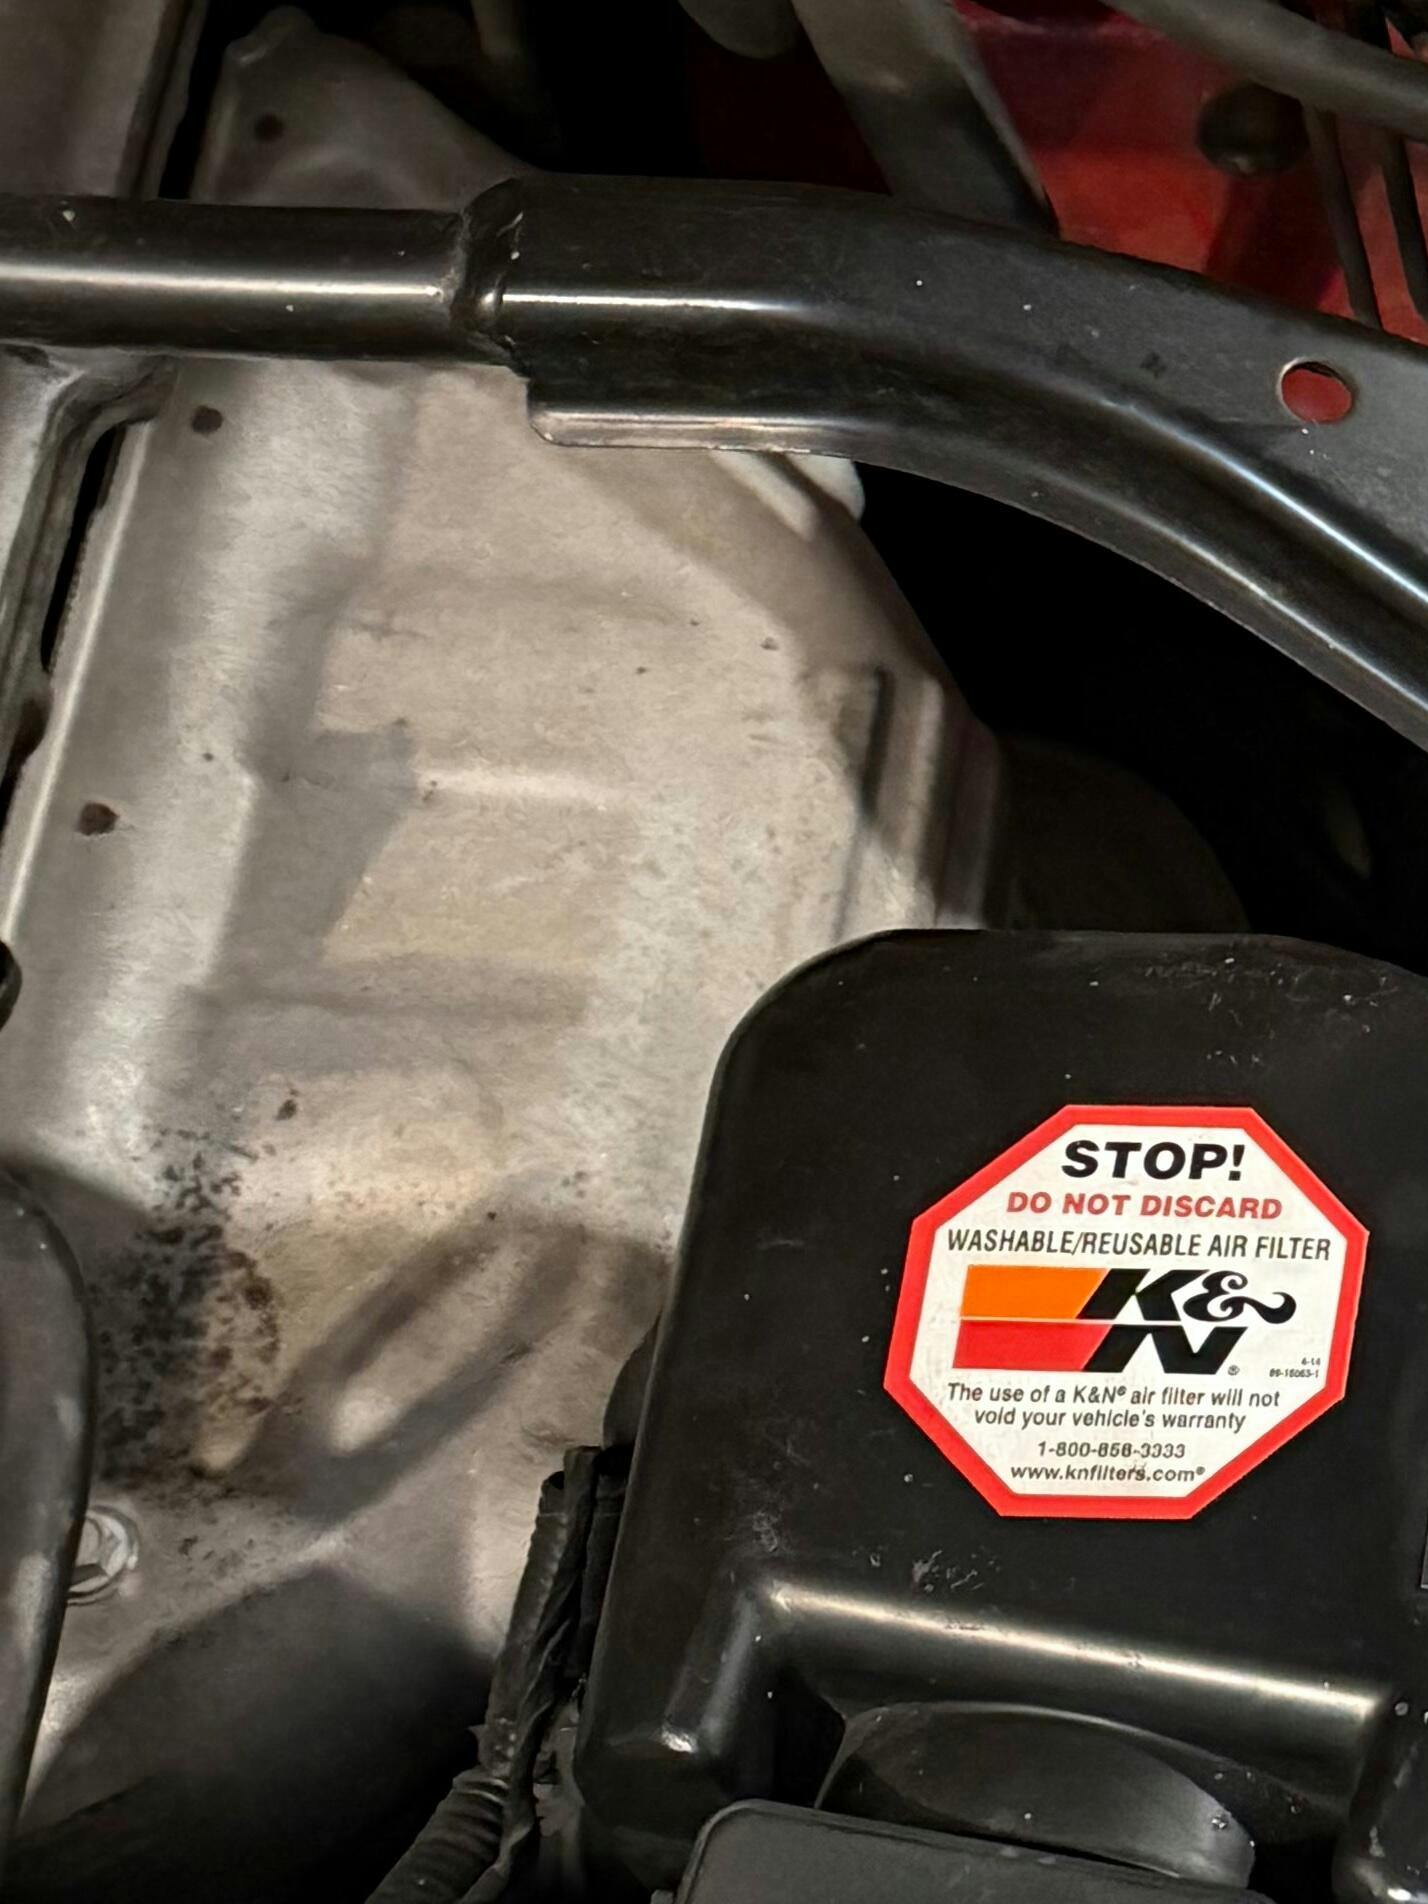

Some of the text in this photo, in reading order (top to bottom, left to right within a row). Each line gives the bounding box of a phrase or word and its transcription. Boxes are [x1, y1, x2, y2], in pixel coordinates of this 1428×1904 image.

[1060, 1139, 1247, 1181] STOP!
[1006, 1191, 1284, 1220] DO NOT DISCARD
[947, 1228, 1332, 1261] WASHABLE/REUSABLE AIR FILTER
[947, 1381, 984, 1402] The
[989, 1386, 1024, 1403] use
[1030, 1383, 1052, 1404] of
[1054, 1388, 1067, 1404] a
[1130, 1385, 1156, 1406] air
[1161, 1385, 1206, 1407] filter
[1211, 1387, 1244, 1408] will
[1248, 1389, 1281, 1409] not
[974, 1407, 1247, 1435] void your vehicle's warranty
[1037, 1440, 1187, 1460] 1-800-858-3333
